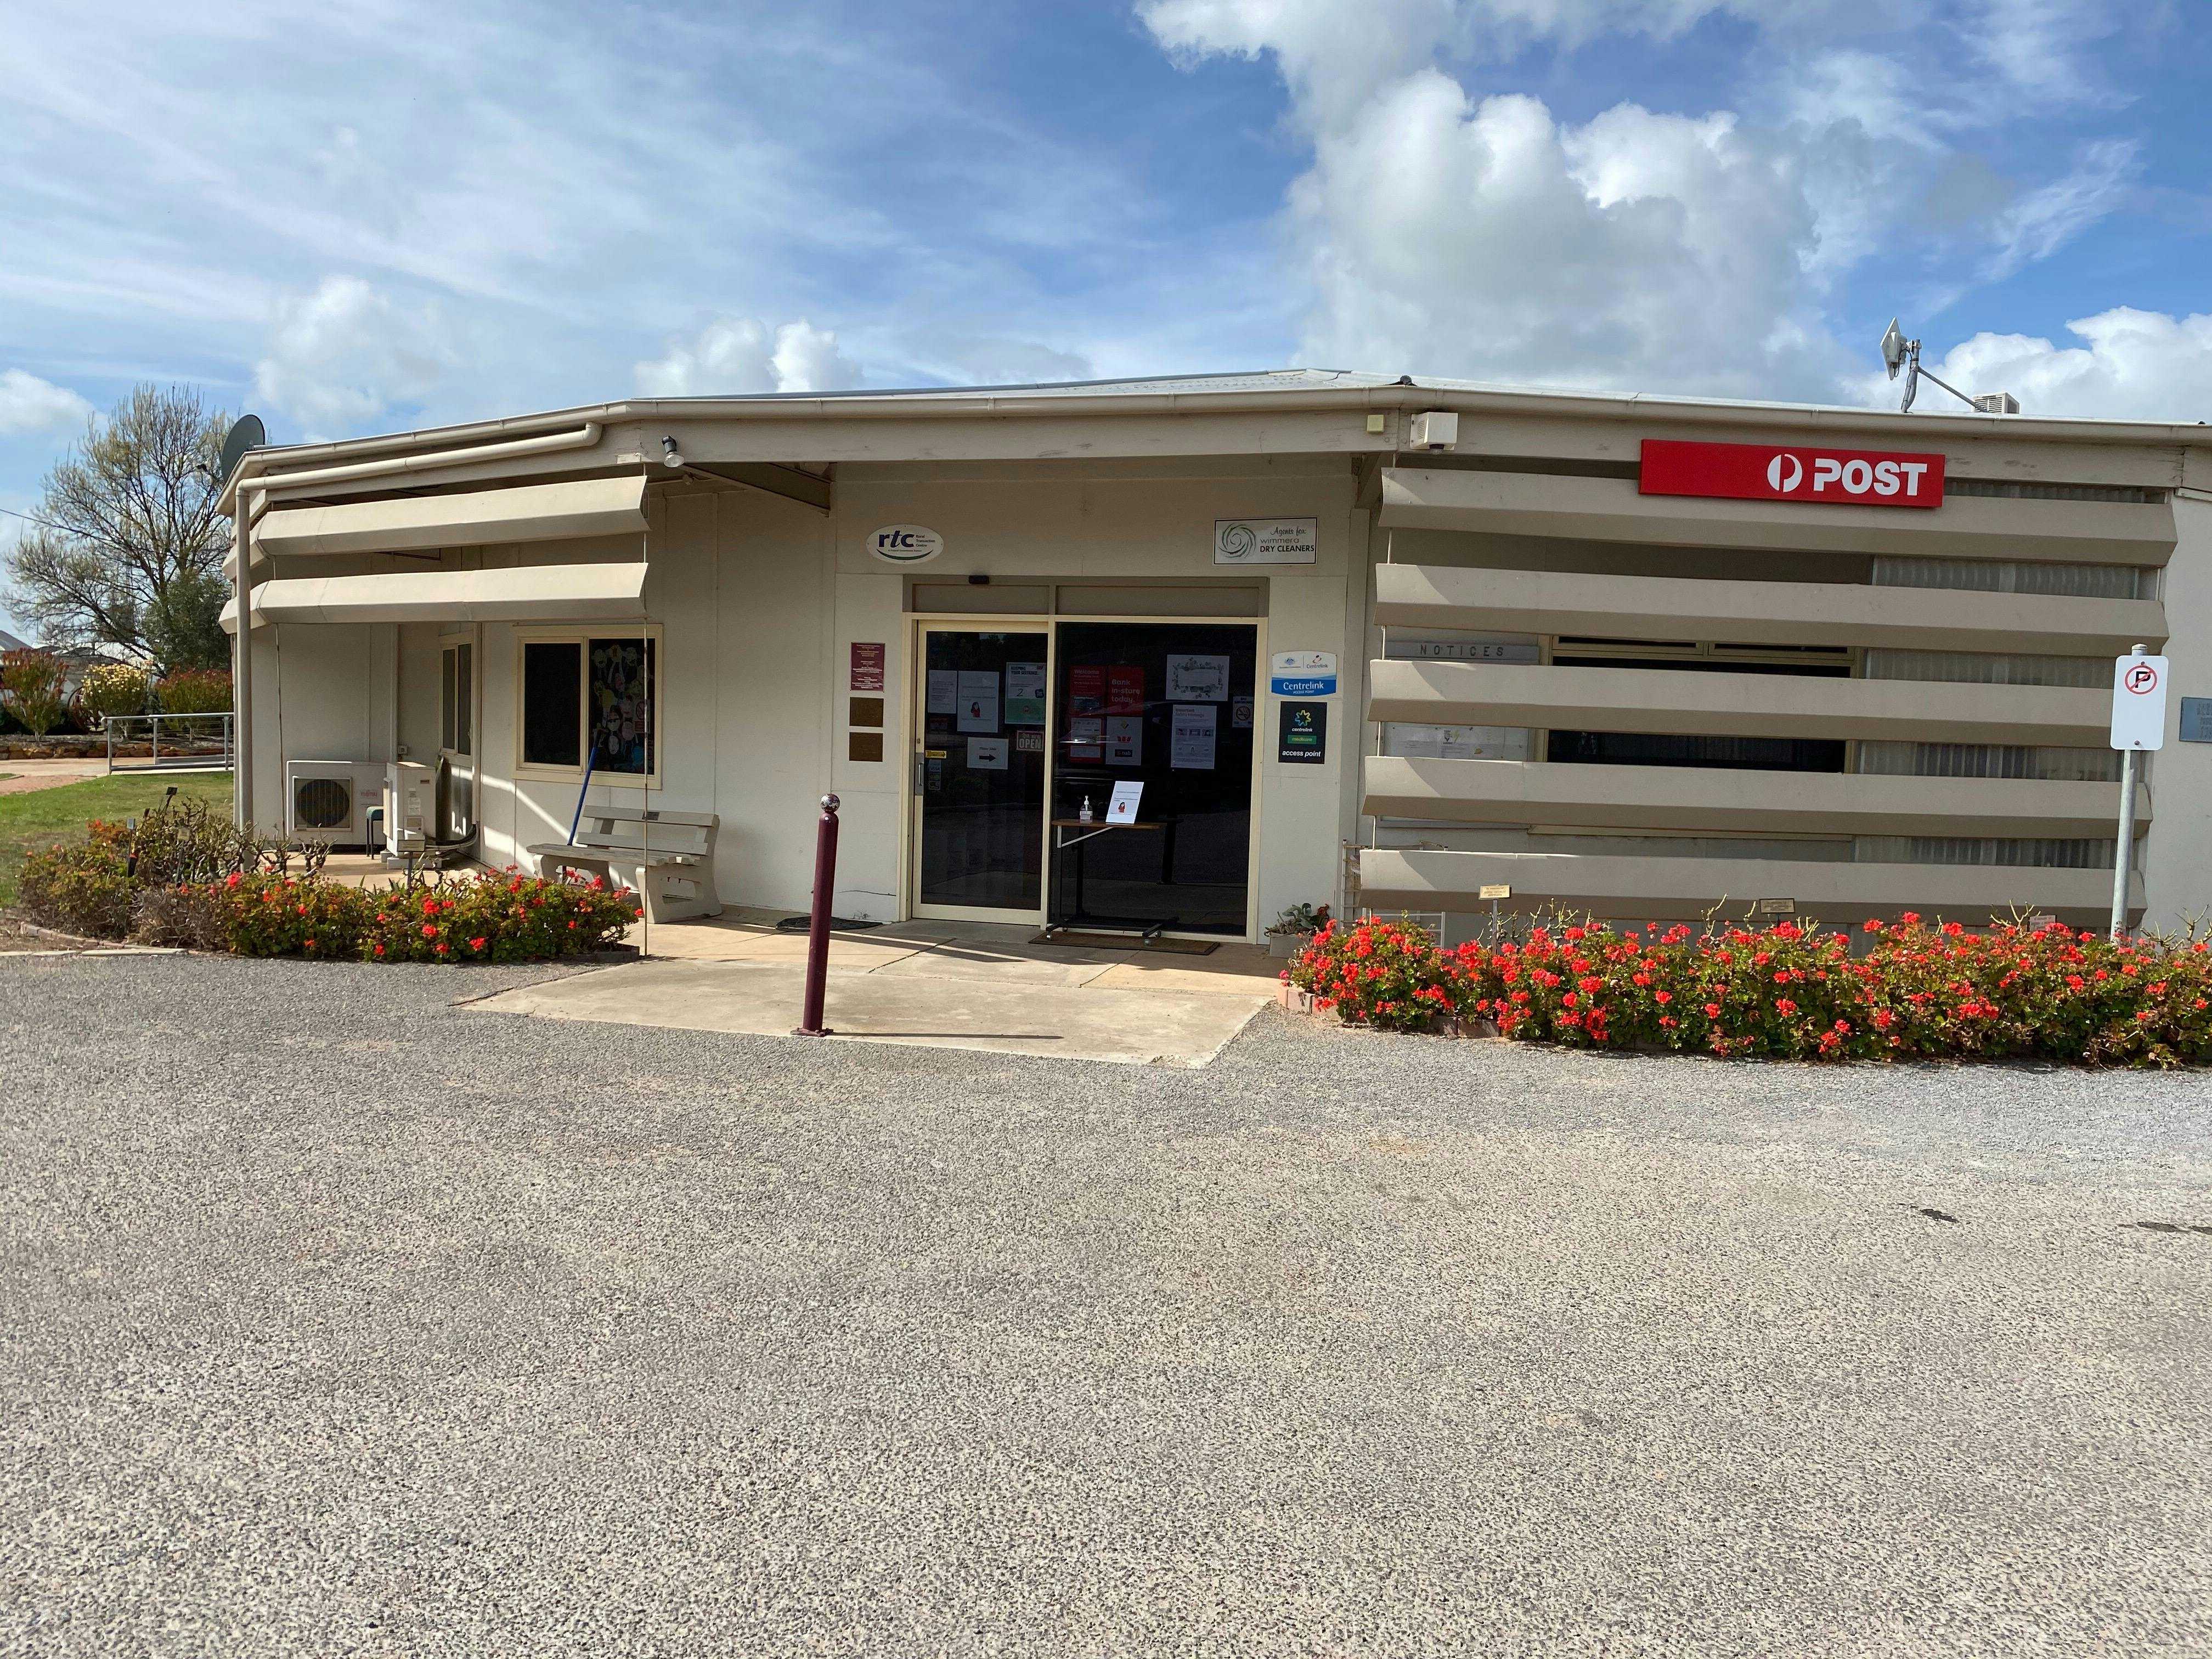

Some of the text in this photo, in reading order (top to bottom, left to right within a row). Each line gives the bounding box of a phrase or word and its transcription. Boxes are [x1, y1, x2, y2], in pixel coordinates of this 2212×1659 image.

[1813, 458, 1927, 496] POST
[1270, 526, 1307, 537] Agents for
[879, 530, 915, 548] rtc
[1420, 644, 1504, 657] NOTICES
[1283, 681, 1324, 690] Centrelink
[1019, 738, 1041, 749] OPEN
